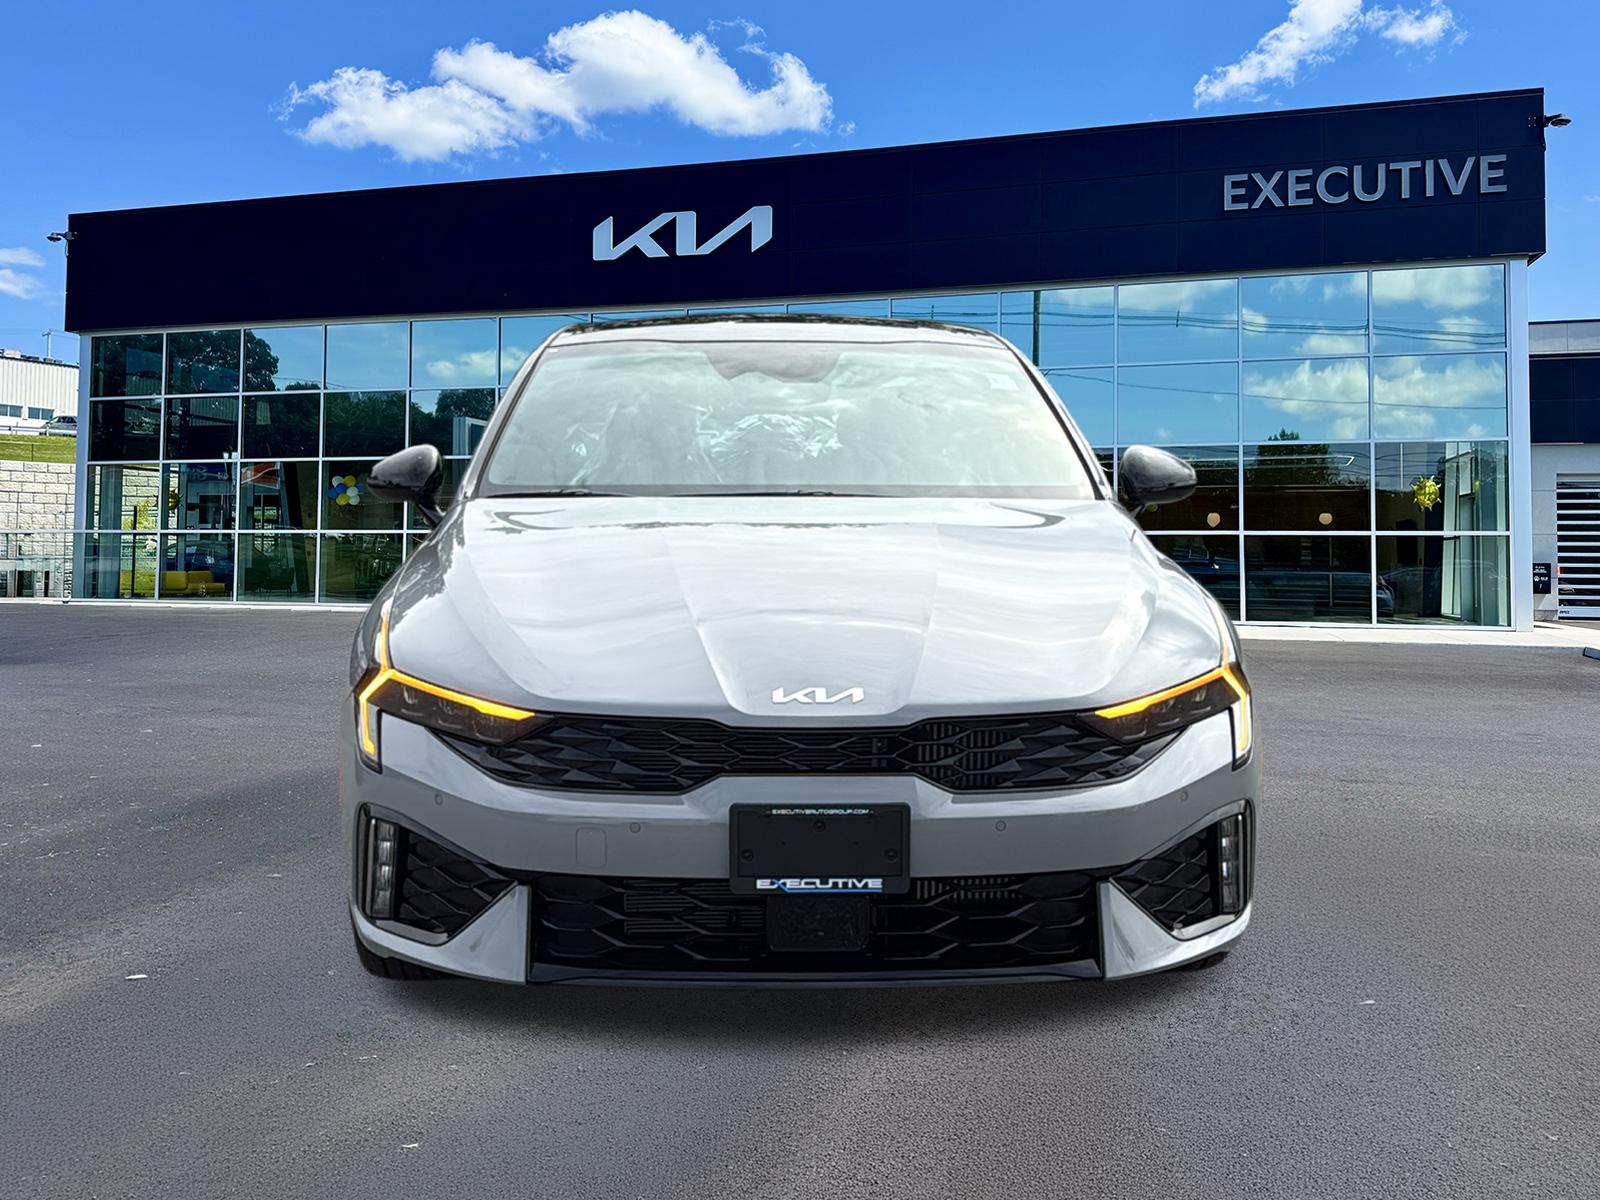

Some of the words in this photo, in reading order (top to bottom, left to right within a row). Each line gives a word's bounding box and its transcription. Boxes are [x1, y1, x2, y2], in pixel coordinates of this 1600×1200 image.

[1222, 153, 1508, 212] EXECUTIVE
[592, 205, 773, 262] KIA
[772, 687, 865, 704] KIA
[756, 878, 883, 892] EXECUTIVE
